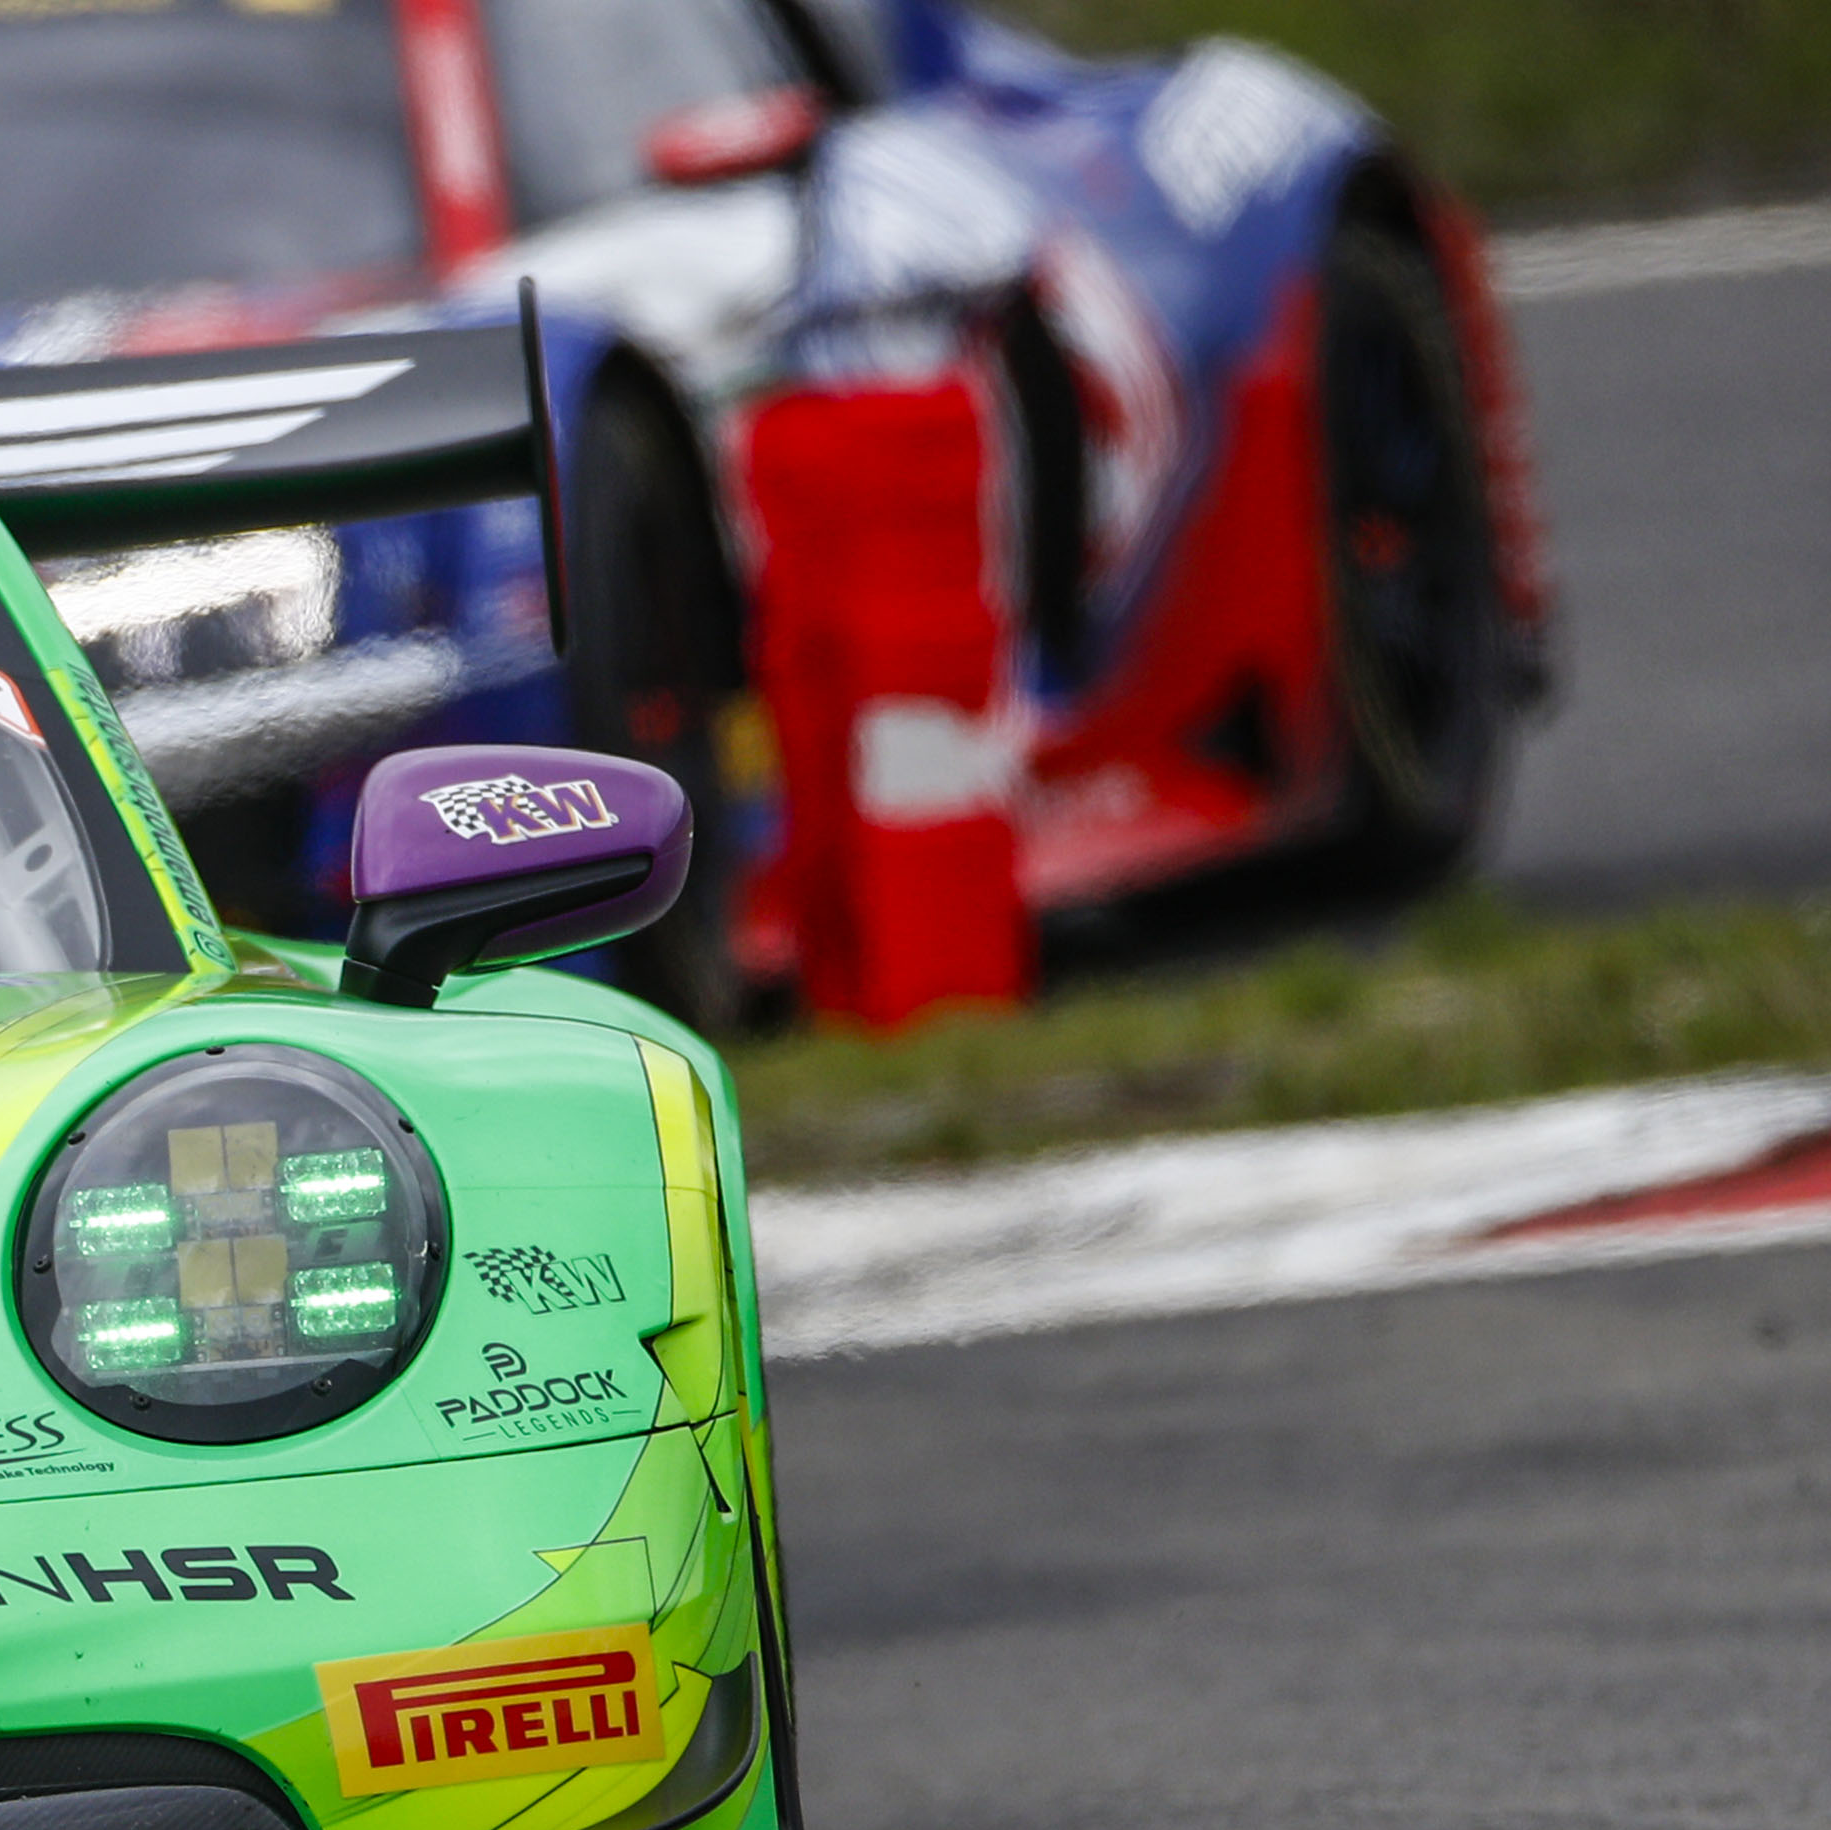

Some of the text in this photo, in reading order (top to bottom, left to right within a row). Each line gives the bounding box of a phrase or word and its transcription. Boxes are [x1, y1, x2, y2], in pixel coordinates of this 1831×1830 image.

[435, 1368, 628, 1429] PADDOCK
[498, 1406, 611, 1439] LEGENDS
[26, 1460, 116, 1478] Technology
[354, 1649, 641, 1769] PIRELLI
